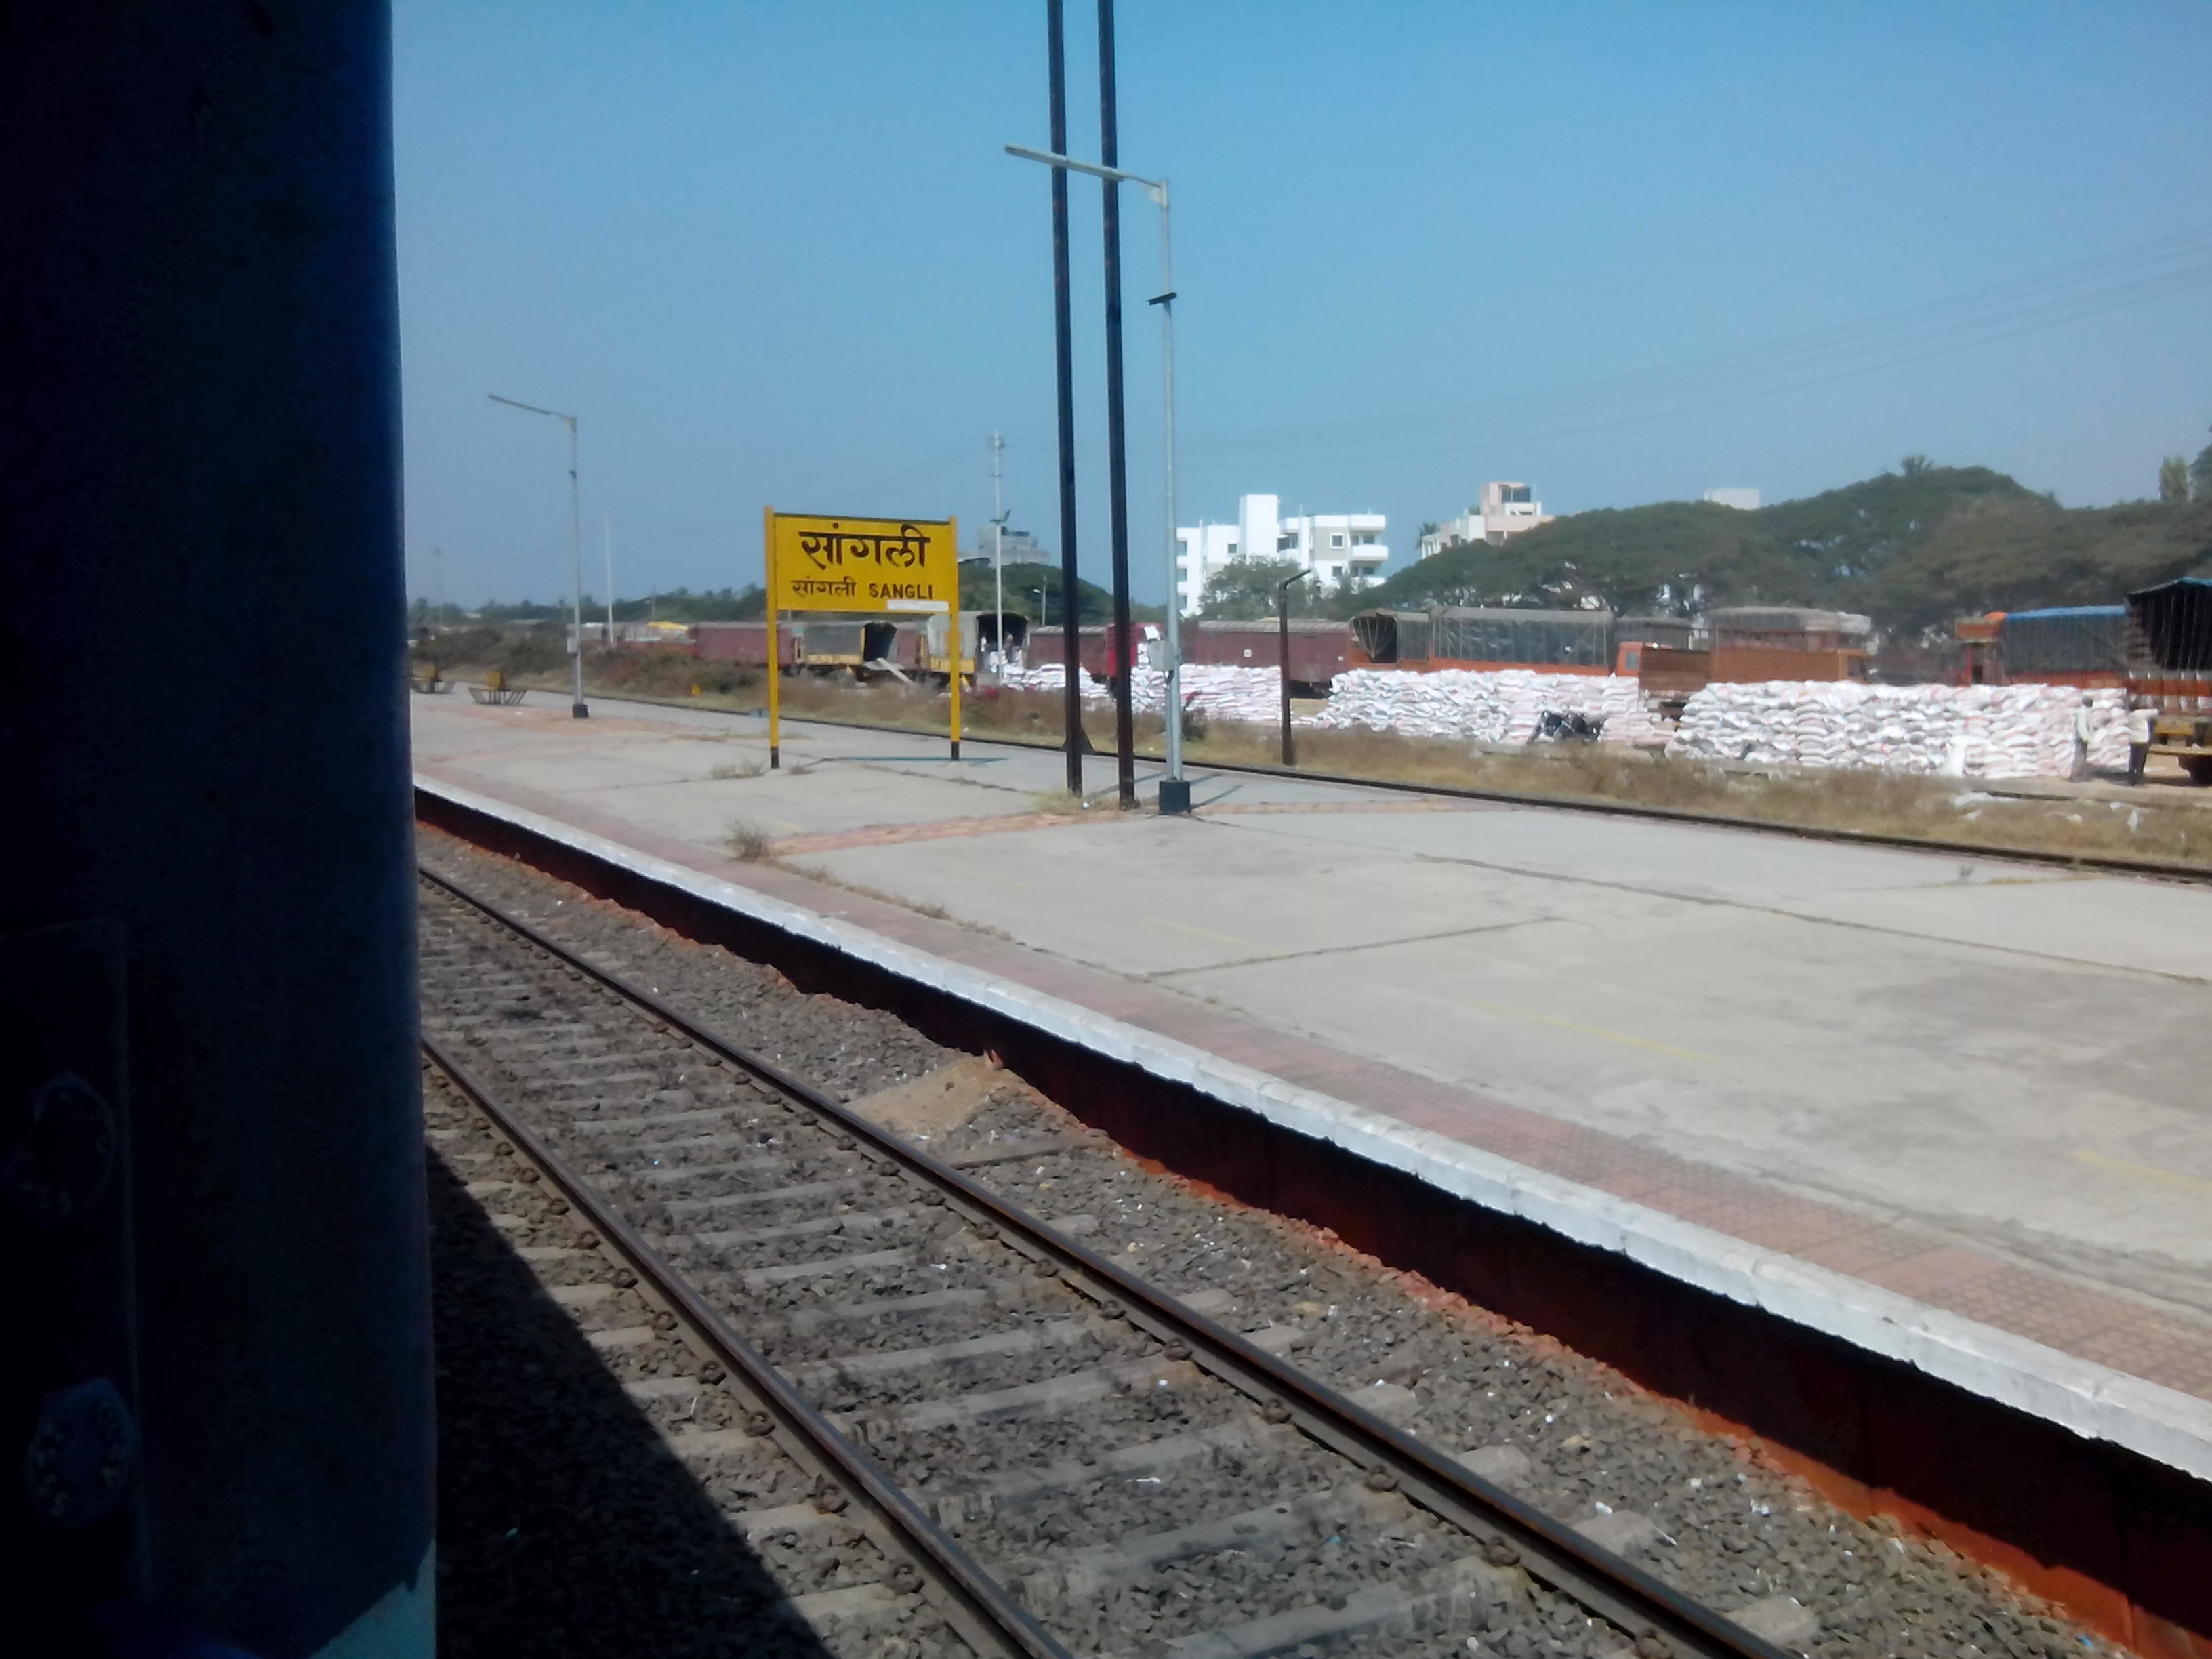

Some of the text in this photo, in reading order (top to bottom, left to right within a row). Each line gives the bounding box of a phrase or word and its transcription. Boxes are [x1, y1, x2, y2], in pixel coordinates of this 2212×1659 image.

[798, 523, 931, 570] सांगली
[791, 576, 857, 598] सांगली
[869, 583, 933, 600] SANGLI
